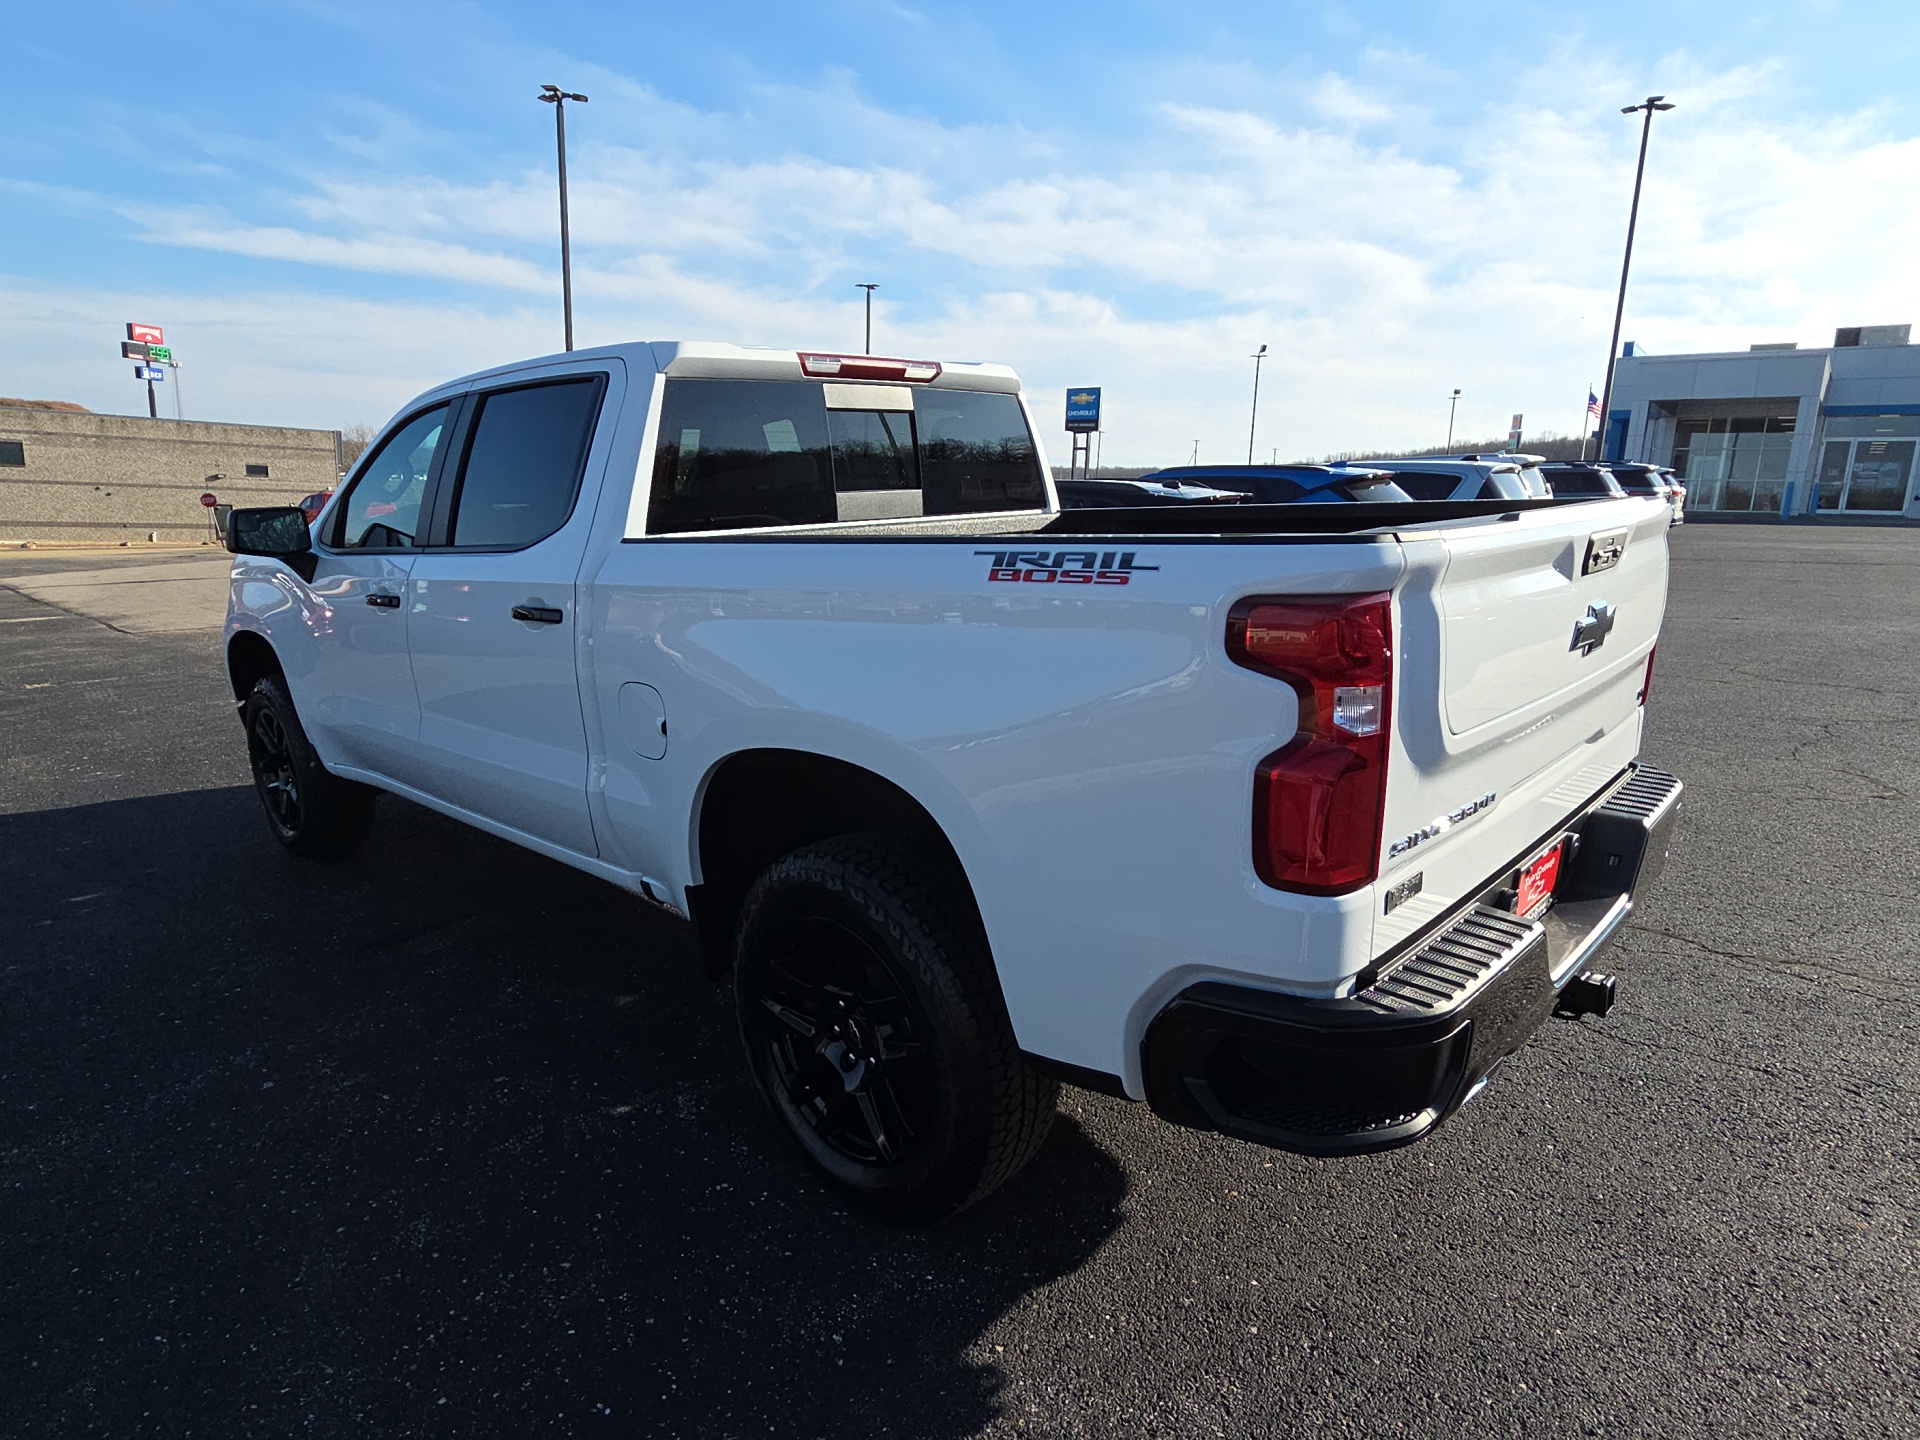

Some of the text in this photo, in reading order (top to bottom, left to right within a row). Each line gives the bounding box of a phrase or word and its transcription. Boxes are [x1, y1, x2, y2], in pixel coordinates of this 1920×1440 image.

[1067, 409, 1096, 417] CHEVROLET
[201, 496, 216, 504] STOP
[973, 550, 1161, 571] TRAIL
[988, 568, 1132, 585] BOSS
[1387, 790, 1498, 861] SILVRADO
